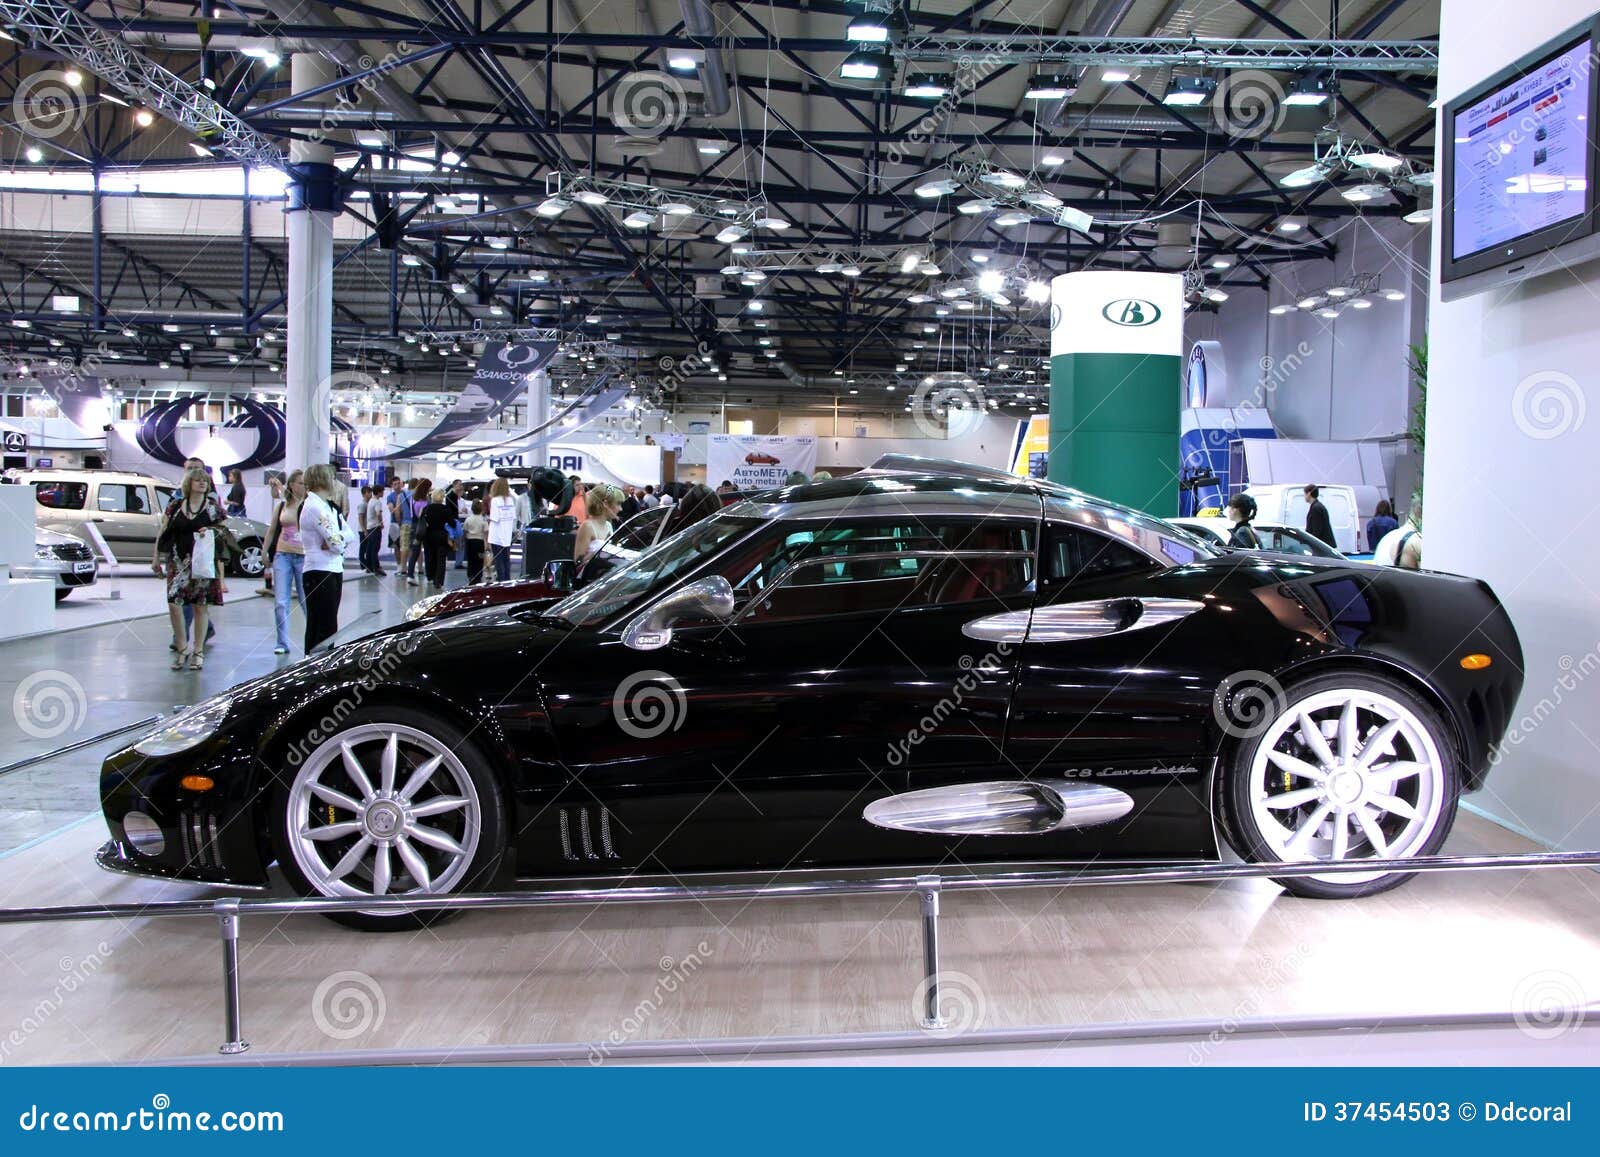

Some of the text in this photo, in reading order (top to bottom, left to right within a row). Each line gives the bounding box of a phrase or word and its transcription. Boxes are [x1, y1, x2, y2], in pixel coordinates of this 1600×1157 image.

[489, 454, 582, 471] HYDAI
[732, 477, 786, 486] auto.meta.u
[1063, 768, 1093, 778] C8
